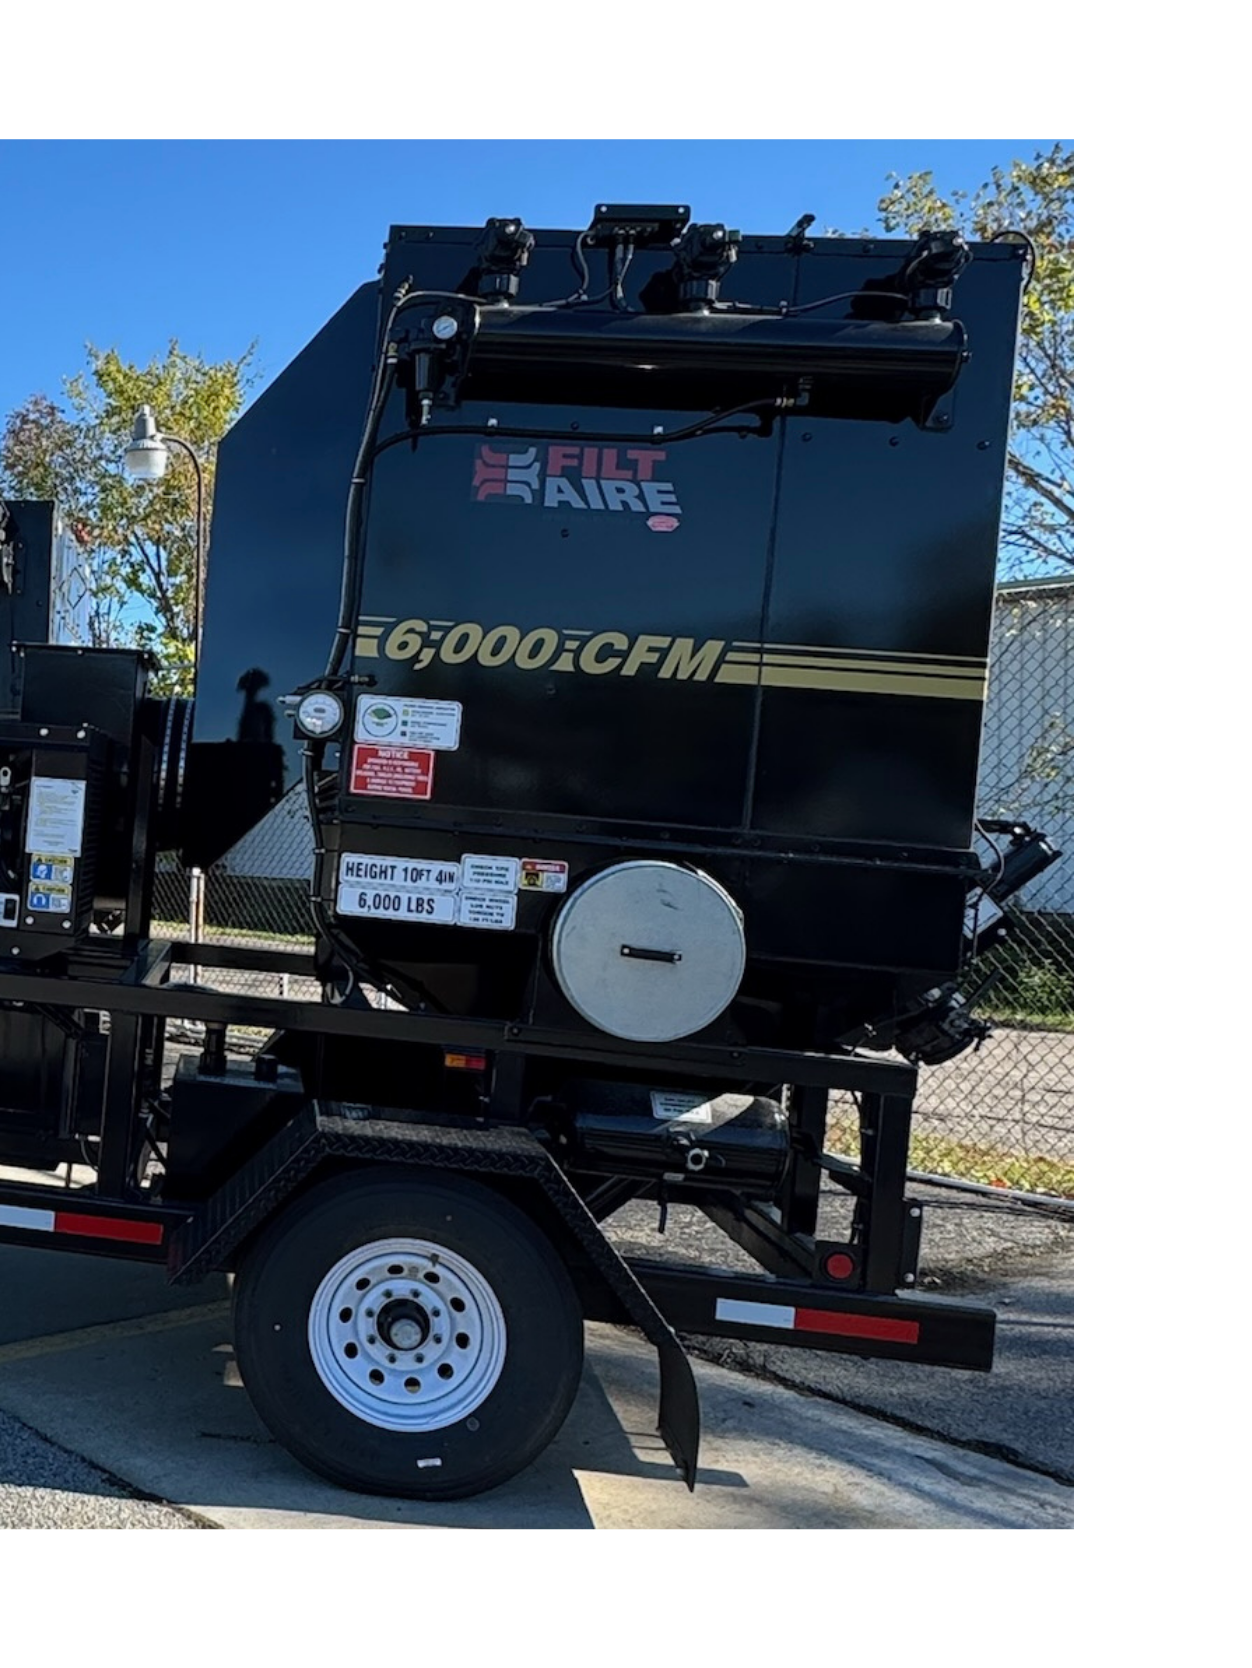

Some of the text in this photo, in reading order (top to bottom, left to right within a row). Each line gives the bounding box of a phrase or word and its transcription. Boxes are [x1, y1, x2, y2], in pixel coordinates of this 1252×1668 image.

[547, 446, 666, 480] FILT
[544, 477, 682, 514] AIRE
[385, 619, 726, 682] 6,000 CFM
[377, 750, 409, 759] NOTICE
[345, 861, 456, 885] HEIGHT 10FT 4IN
[358, 892, 435, 915] 6,000 LBS
